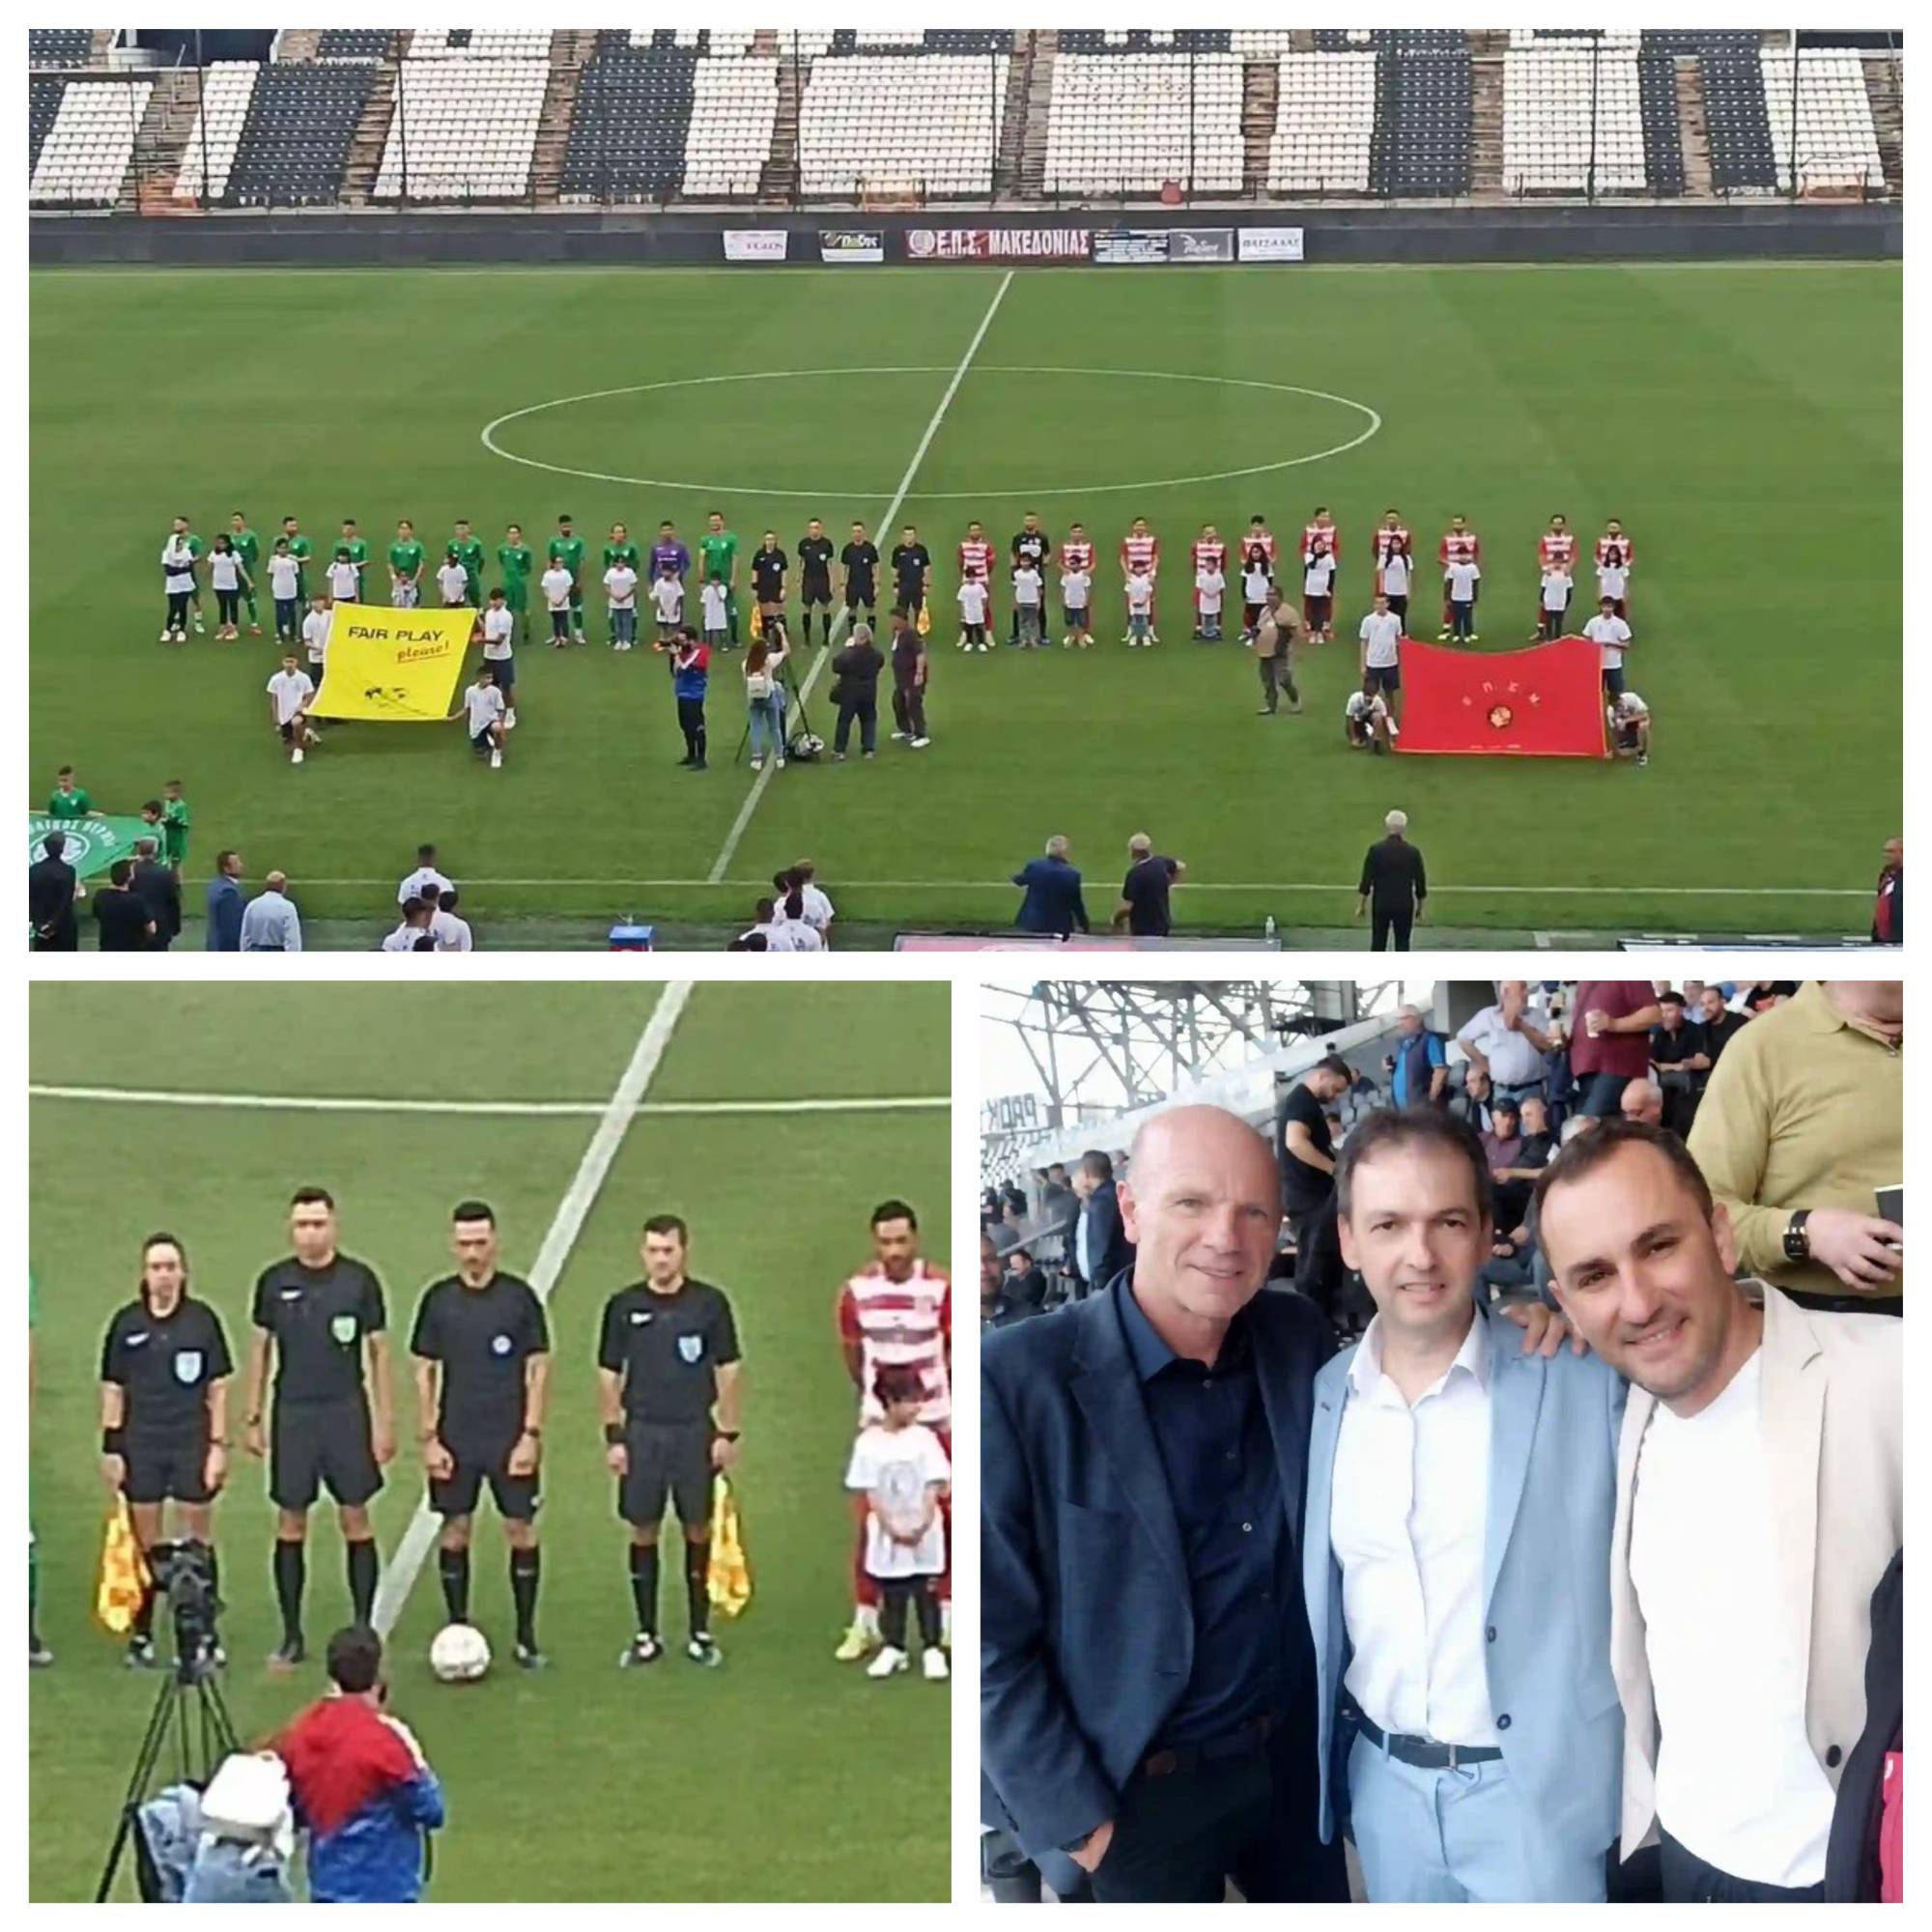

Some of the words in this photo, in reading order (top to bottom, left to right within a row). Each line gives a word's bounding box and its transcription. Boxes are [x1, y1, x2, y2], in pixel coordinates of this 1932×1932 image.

[937, 230, 981, 254] Ε.Π.Σ.
[988, 230, 1090, 255] ΜΑΚΕΔΟΝΙΑΣ
[348, 626, 388, 639] FAIR
[395, 630, 444, 642] PLAY
[397, 640, 449, 663] please!
